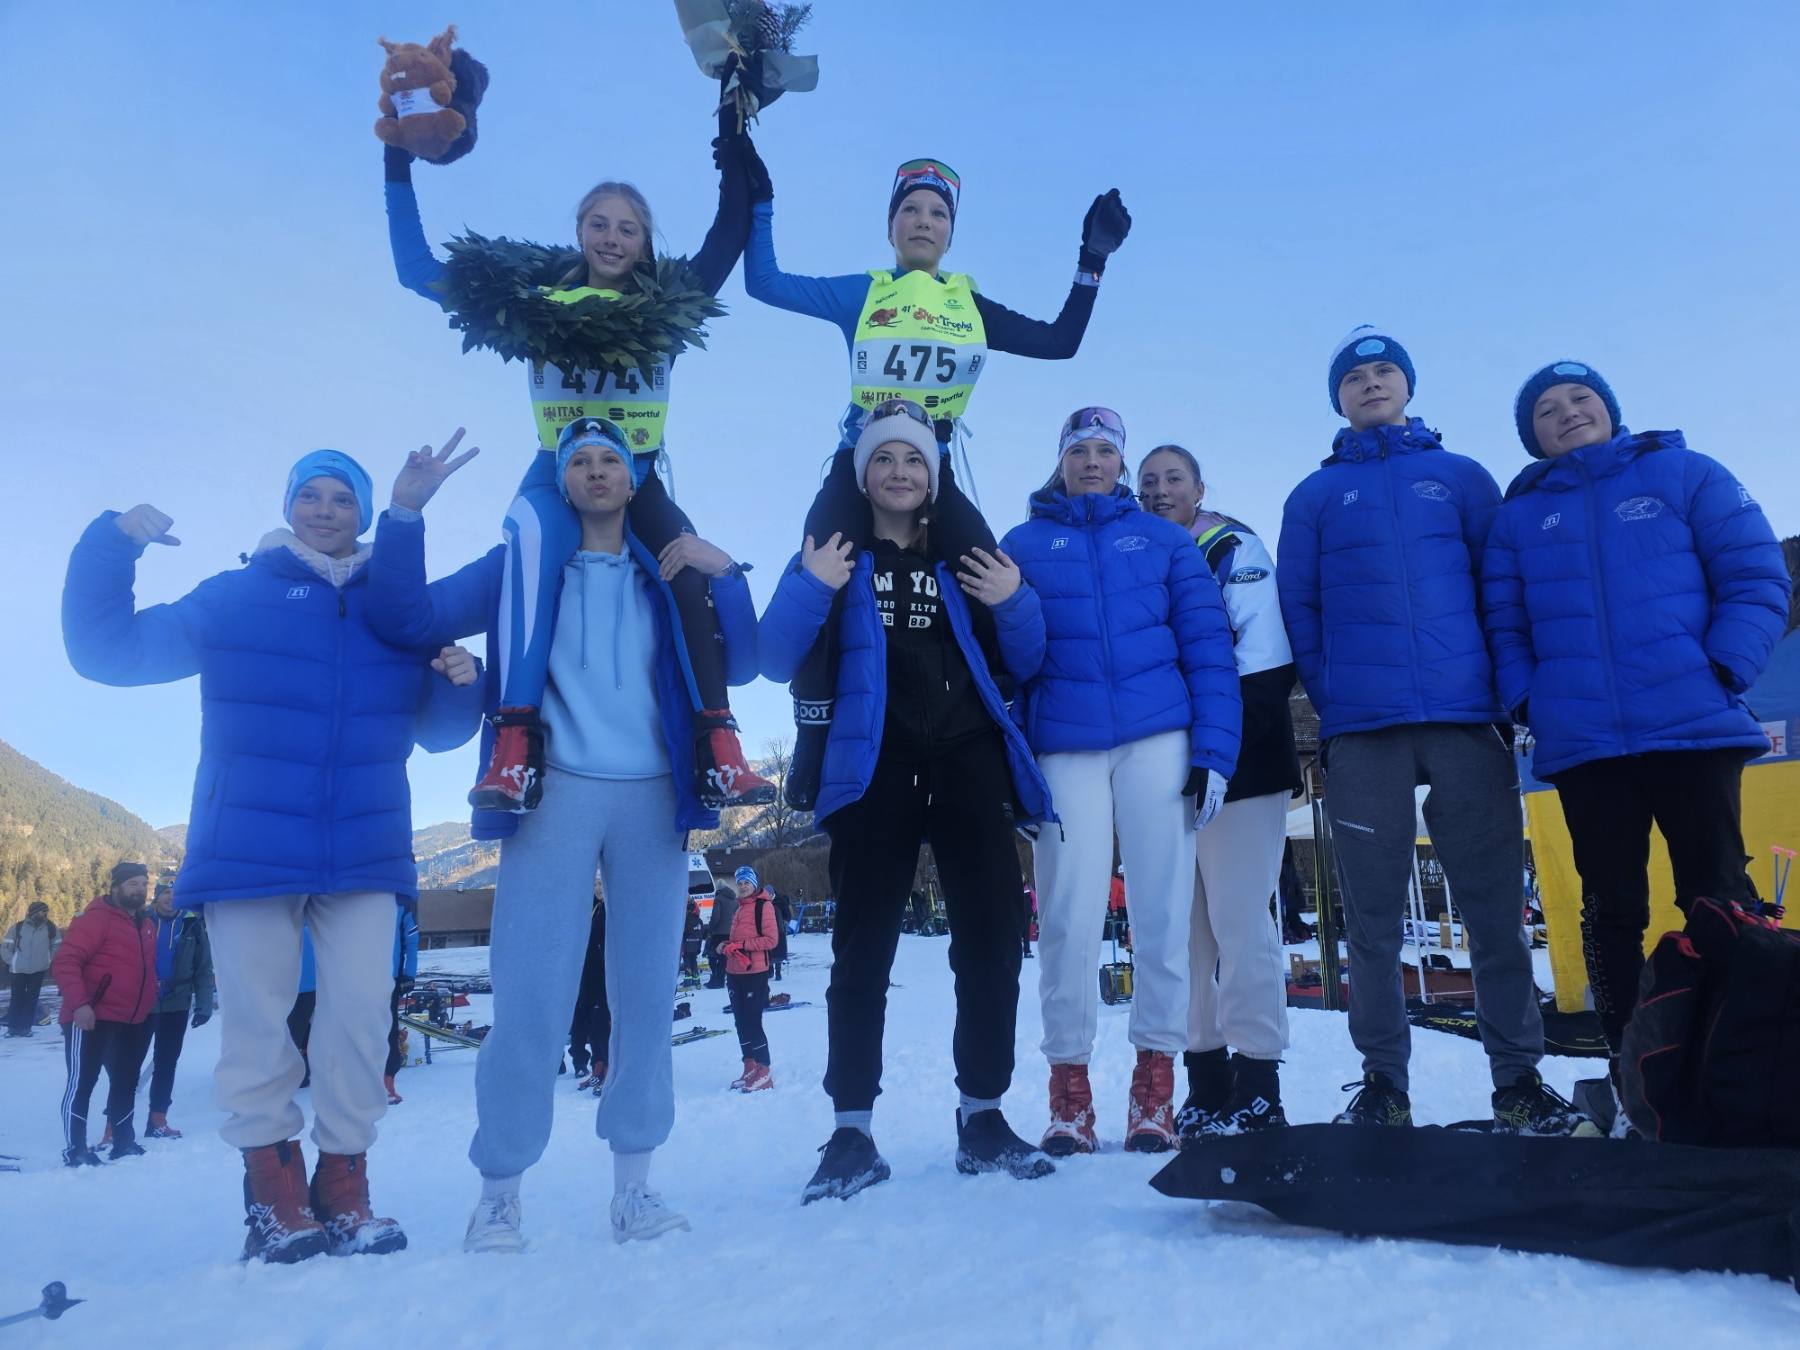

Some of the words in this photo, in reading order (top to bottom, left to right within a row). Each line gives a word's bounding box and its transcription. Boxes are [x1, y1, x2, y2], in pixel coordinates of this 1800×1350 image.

[883, 344, 957, 383] 475
[876, 391, 902, 401] ITAS
[556, 406, 585, 417] ITAS
[627, 410, 660, 419] sportful
[1235, 570, 1262, 582] Ford
[910, 570, 941, 598] YO
[910, 603, 937, 613] KLYN
[911, 617, 926, 627] 88
